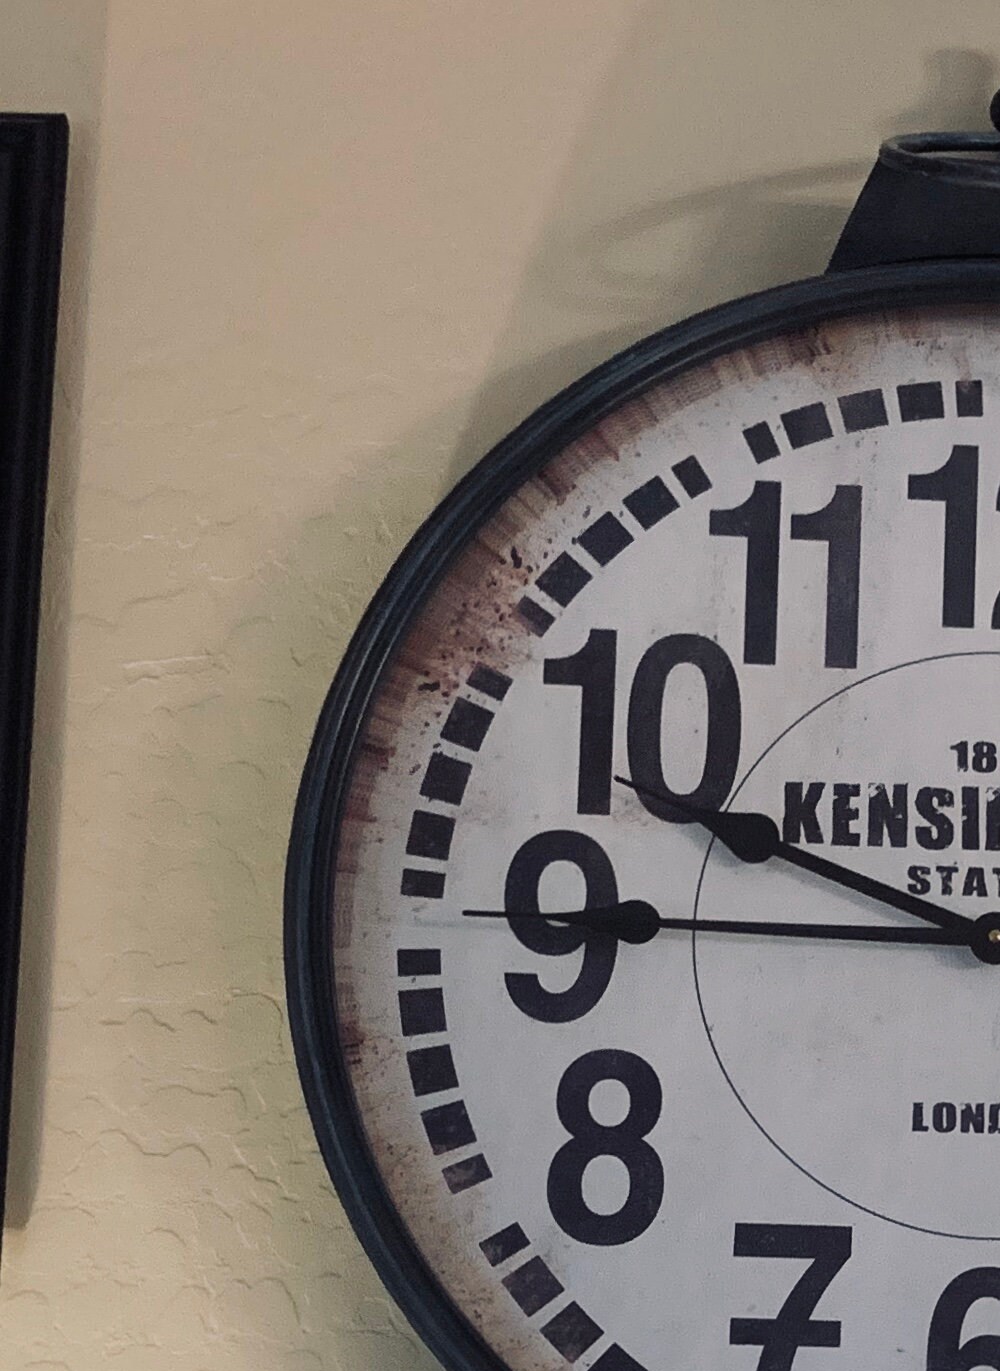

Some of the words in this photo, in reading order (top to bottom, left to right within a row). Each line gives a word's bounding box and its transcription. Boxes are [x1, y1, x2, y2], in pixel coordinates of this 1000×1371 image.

[708, 480, 863, 669] 11
[542, 628, 742, 825] 10
[503, 829, 620, 1023] 9
[546, 1048, 665, 1247] 8
